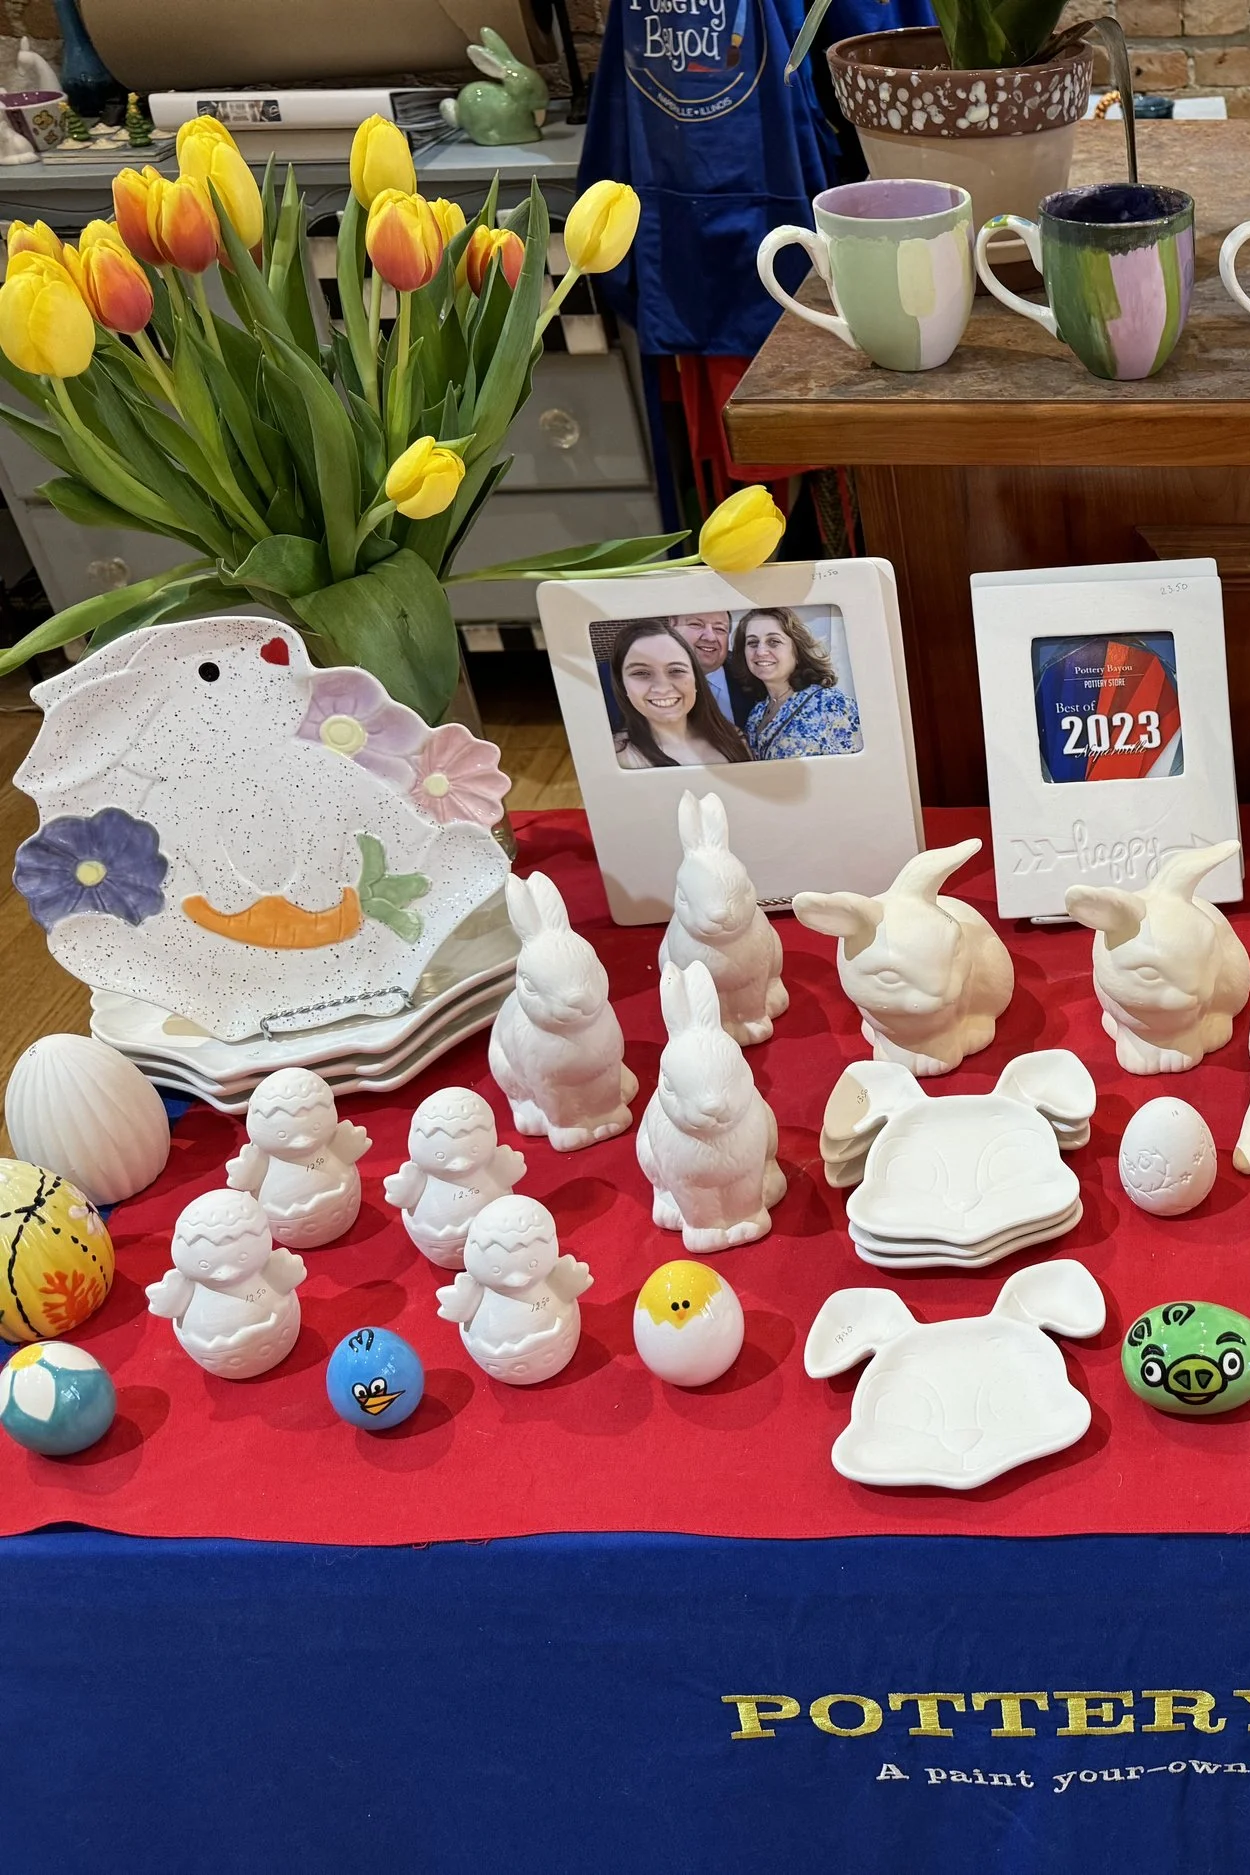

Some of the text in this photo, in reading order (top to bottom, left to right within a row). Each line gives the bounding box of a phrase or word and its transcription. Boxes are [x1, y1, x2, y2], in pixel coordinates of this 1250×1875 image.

[1074, 664, 1133, 676] Pottery Bayou
[1084, 678, 1126, 689] POTTERY STORE
[1055, 700, 1097, 714] Best of
[1061, 710, 1161, 755] 2023
[875, 1762, 910, 1781] A
[924, 1766, 1035, 1789] paint
